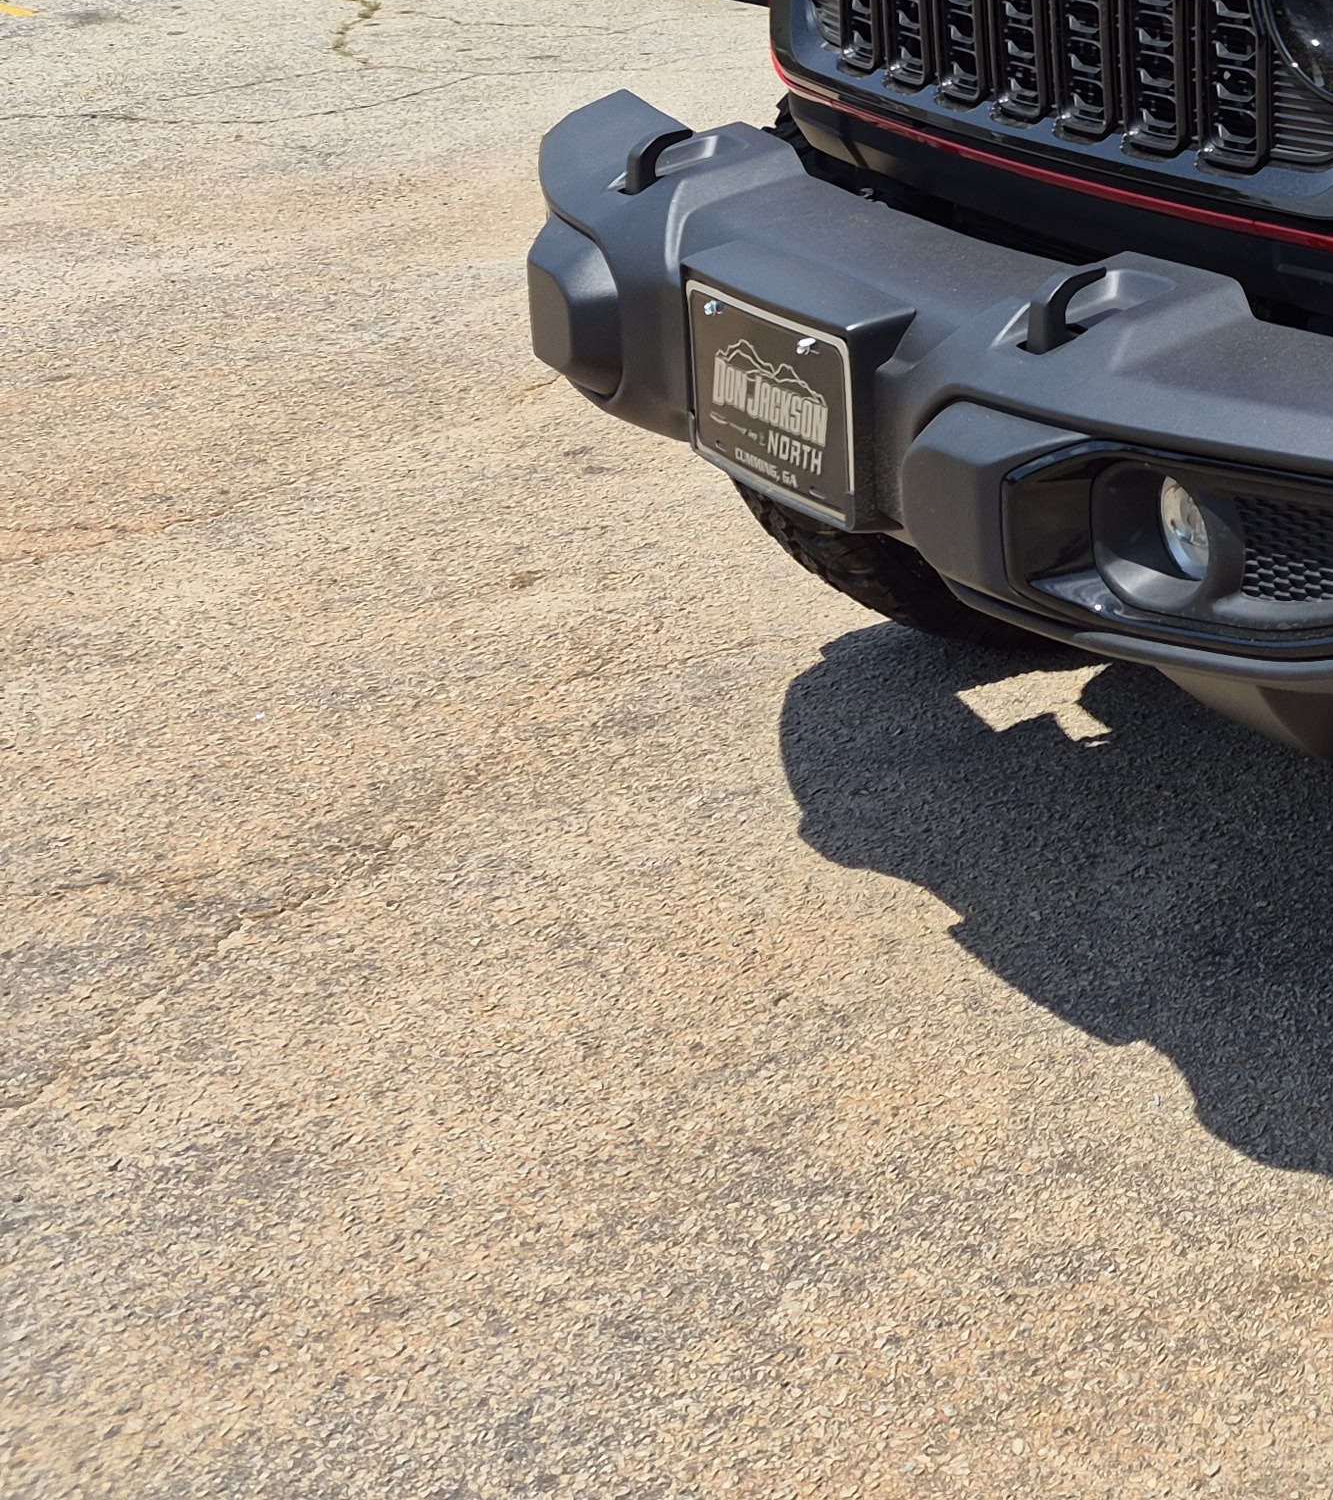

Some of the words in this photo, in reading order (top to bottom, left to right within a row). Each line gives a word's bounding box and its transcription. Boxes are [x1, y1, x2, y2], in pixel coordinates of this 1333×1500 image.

[712, 355, 749, 412] DON
[746, 375, 829, 448] JACKSON
[766, 430, 823, 477] NORTH
[782, 471, 798, 488] GA
